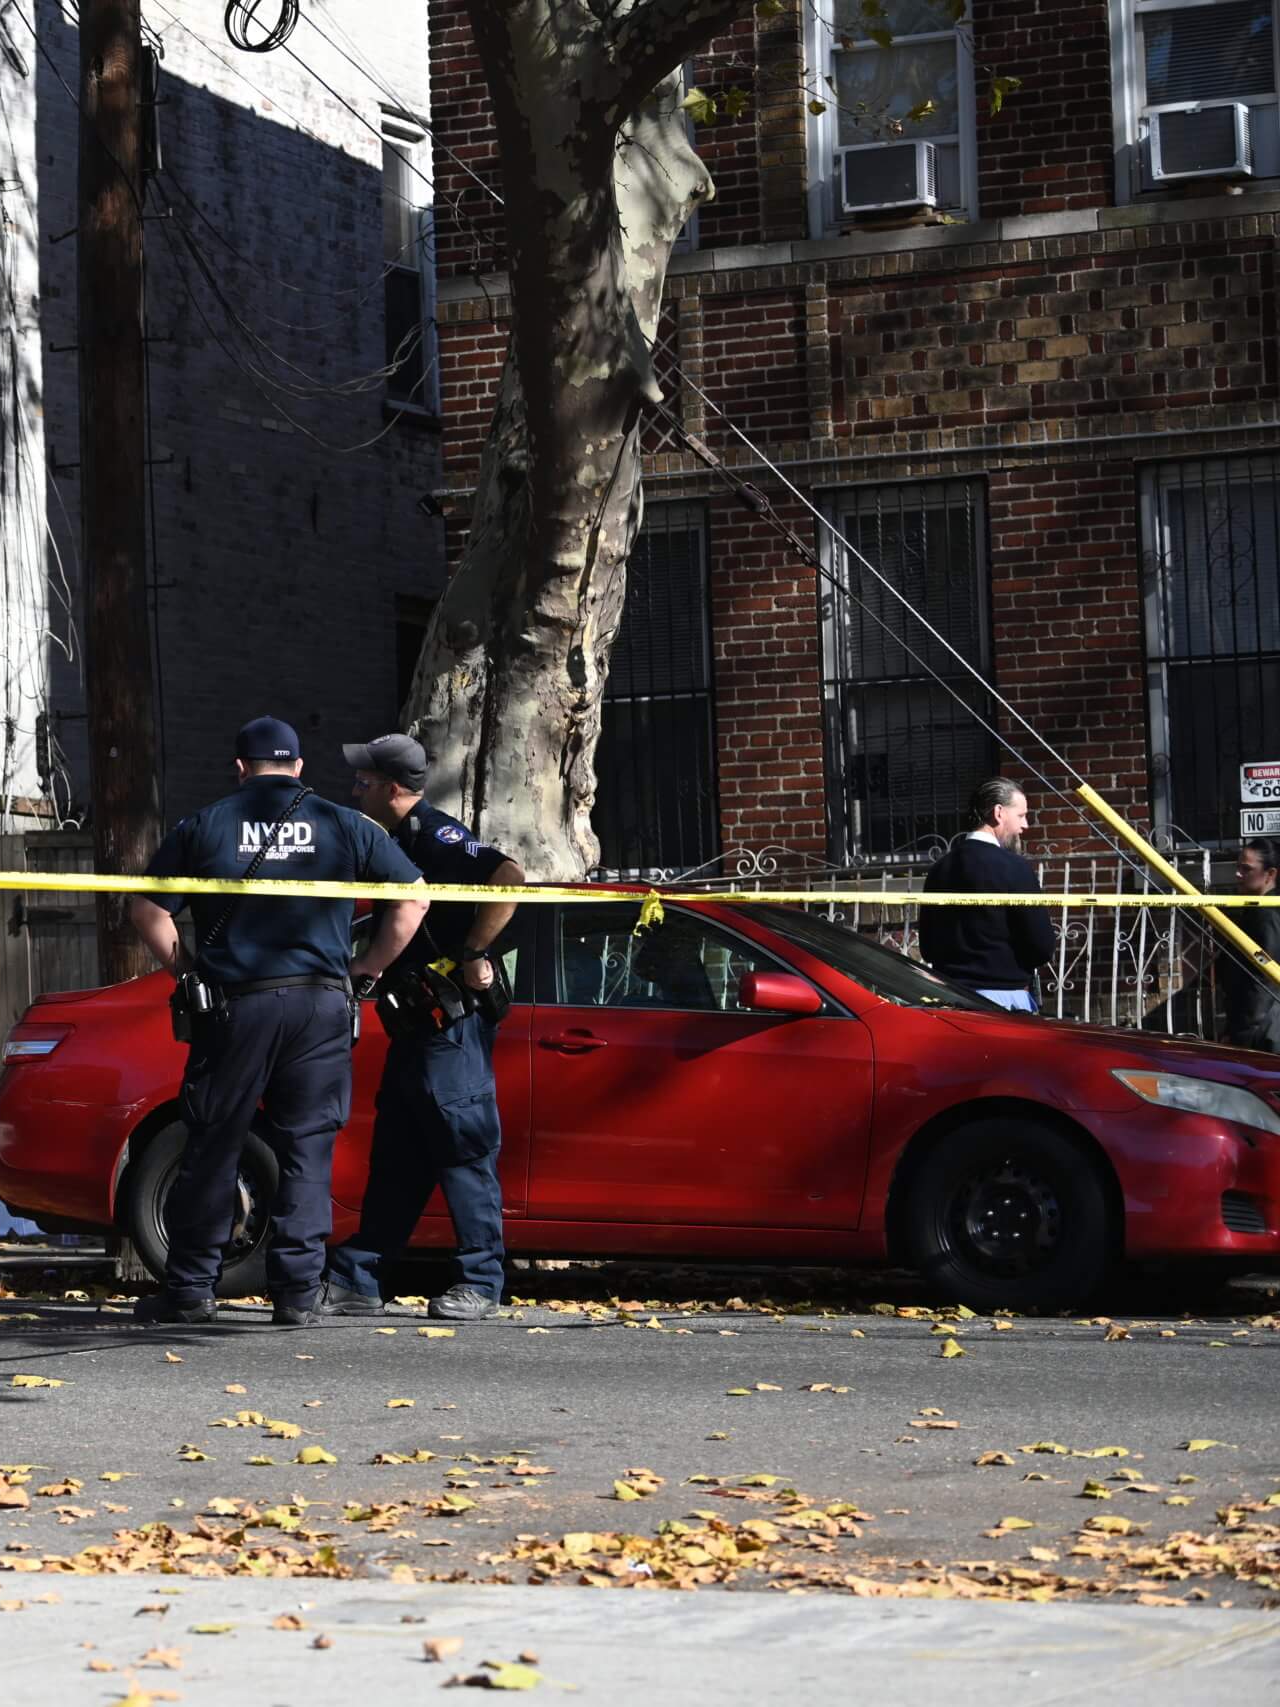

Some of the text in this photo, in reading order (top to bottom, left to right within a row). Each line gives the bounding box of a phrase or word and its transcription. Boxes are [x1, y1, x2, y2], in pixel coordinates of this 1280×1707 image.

[1263, 786, 1280, 797] DO
[1248, 814, 1264, 831] NO
[242, 821, 312, 845] NYPD
